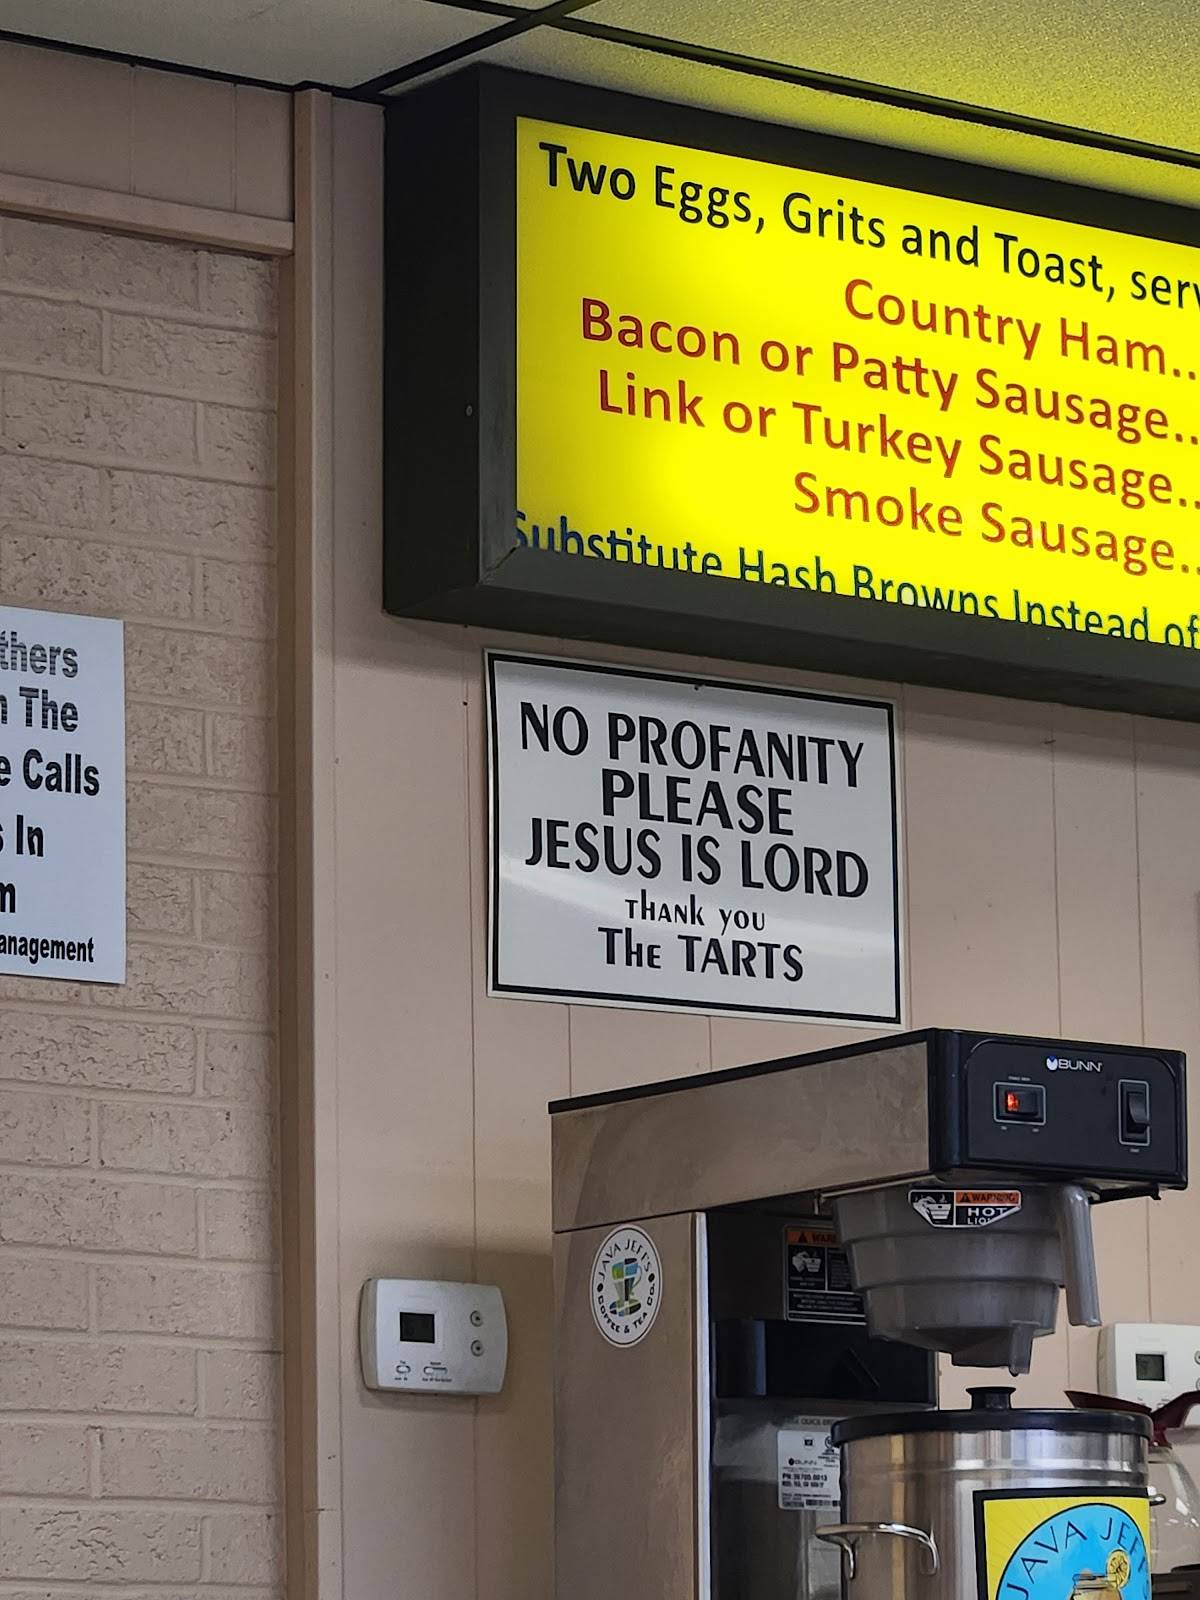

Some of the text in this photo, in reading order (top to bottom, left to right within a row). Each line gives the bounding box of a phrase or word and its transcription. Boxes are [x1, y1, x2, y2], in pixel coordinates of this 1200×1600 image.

[539, 142, 636, 200] Two
[655, 165, 765, 234] Eggs,
[782, 192, 886, 249] Grits
[902, 225, 979, 267] and
[994, 232, 1115, 303] Toast,
[845, 278, 1041, 361] Country
[582, 297, 740, 365] Bacon
[760, 340, 813, 376] or
[833, 342, 958, 412] Patty
[600, 369, 705, 428] Link
[722, 401, 776, 437] or
[792, 401, 962, 479] Turkey
[794, 472, 963, 537] Smoke
[739, 547, 836, 593] Hash
[853, 564, 1000, 620] Browns
[1013, 588, 1150, 642] Instead
[1165, 614, 1199, 648] of
[19, 686, 78, 732] The
[23, 748, 100, 796] Calls
[520, 701, 864, 788] NO PROFANITY
[602, 768, 794, 836] PLEASE
[16, 814, 44, 857] In
[525, 817, 869, 898] JESUS IS LORD
[677, 934, 804, 982] TARTS
[1058, 1058, 1101, 1073] BUNN
[967, 1207, 1008, 1217] HOT
[967, 1217, 992, 1226] LIQ
[598, 1243, 621, 1282] JAVA
[1006, 1520, 1088, 1600] JAVA
